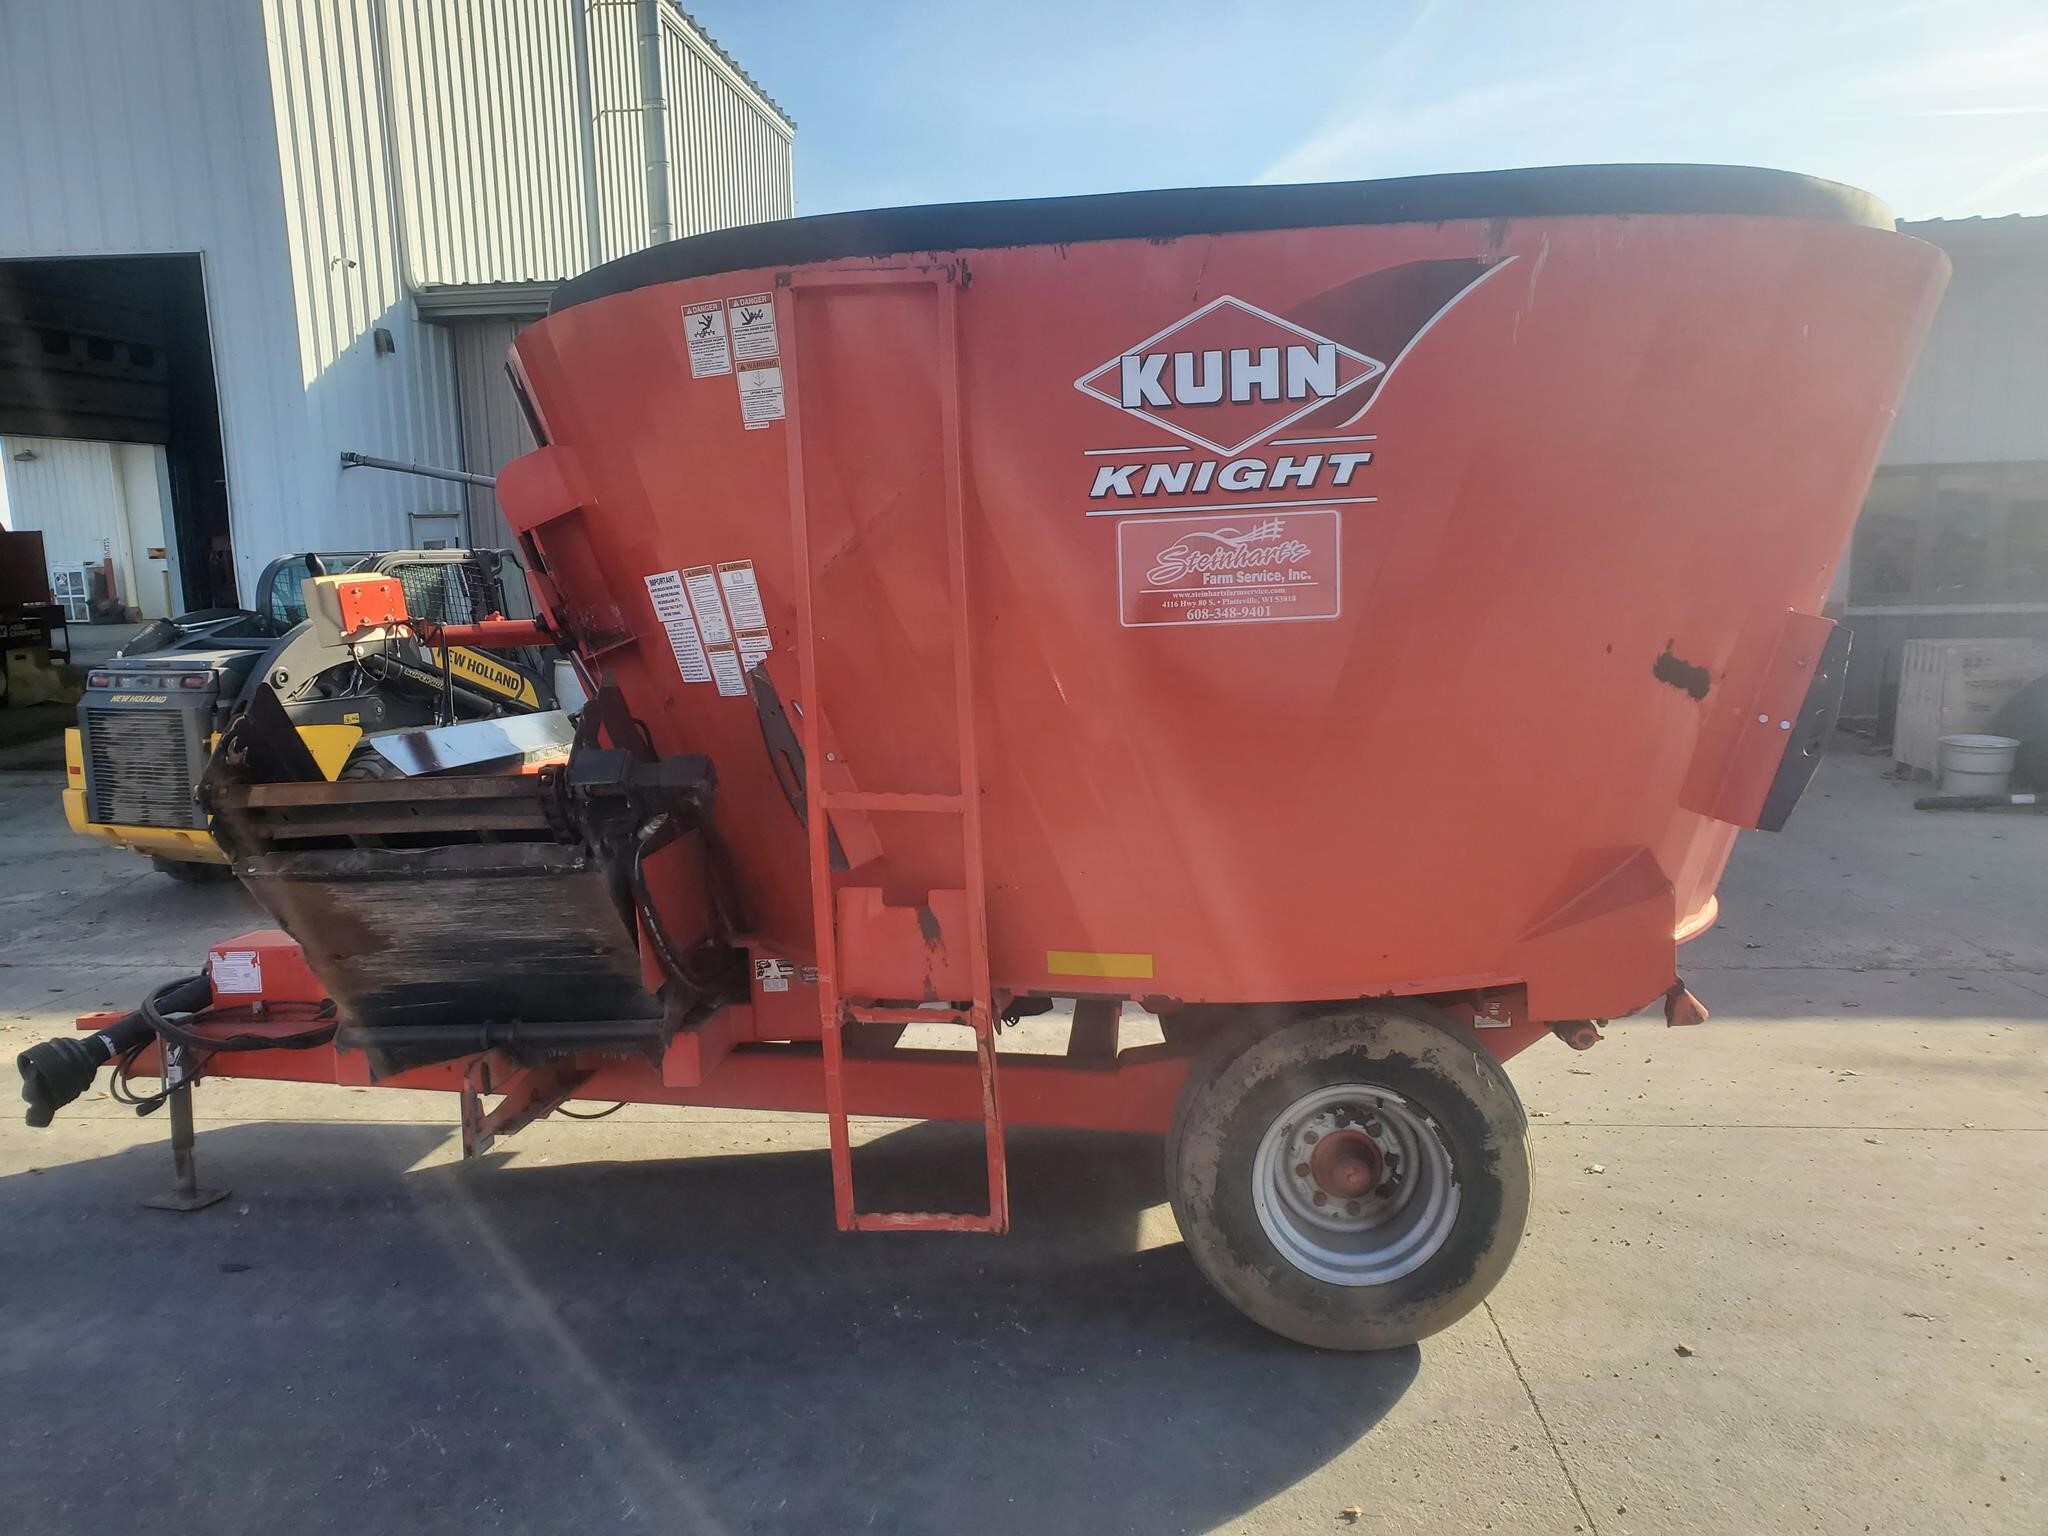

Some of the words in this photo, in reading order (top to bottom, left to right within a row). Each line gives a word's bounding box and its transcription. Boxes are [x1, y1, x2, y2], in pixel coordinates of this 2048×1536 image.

[692, 303, 718, 313] DANGER
[740, 296, 767, 306] DANGER
[1120, 344, 1337, 409] KUHN
[1089, 452, 1373, 498] KNIGHT
[1203, 572, 1233, 585] Farm
[1236, 569, 1285, 584] Service,
[1288, 568, 1312, 581] Inc.
[1180, 600, 1197, 608] Hwy
[1186, 605, 1272, 621] 608-348-9401
[467, 658, 520, 691] HOLLAND
[111, 695, 131, 703] NEW
[129, 695, 167, 703] HOLLAND
